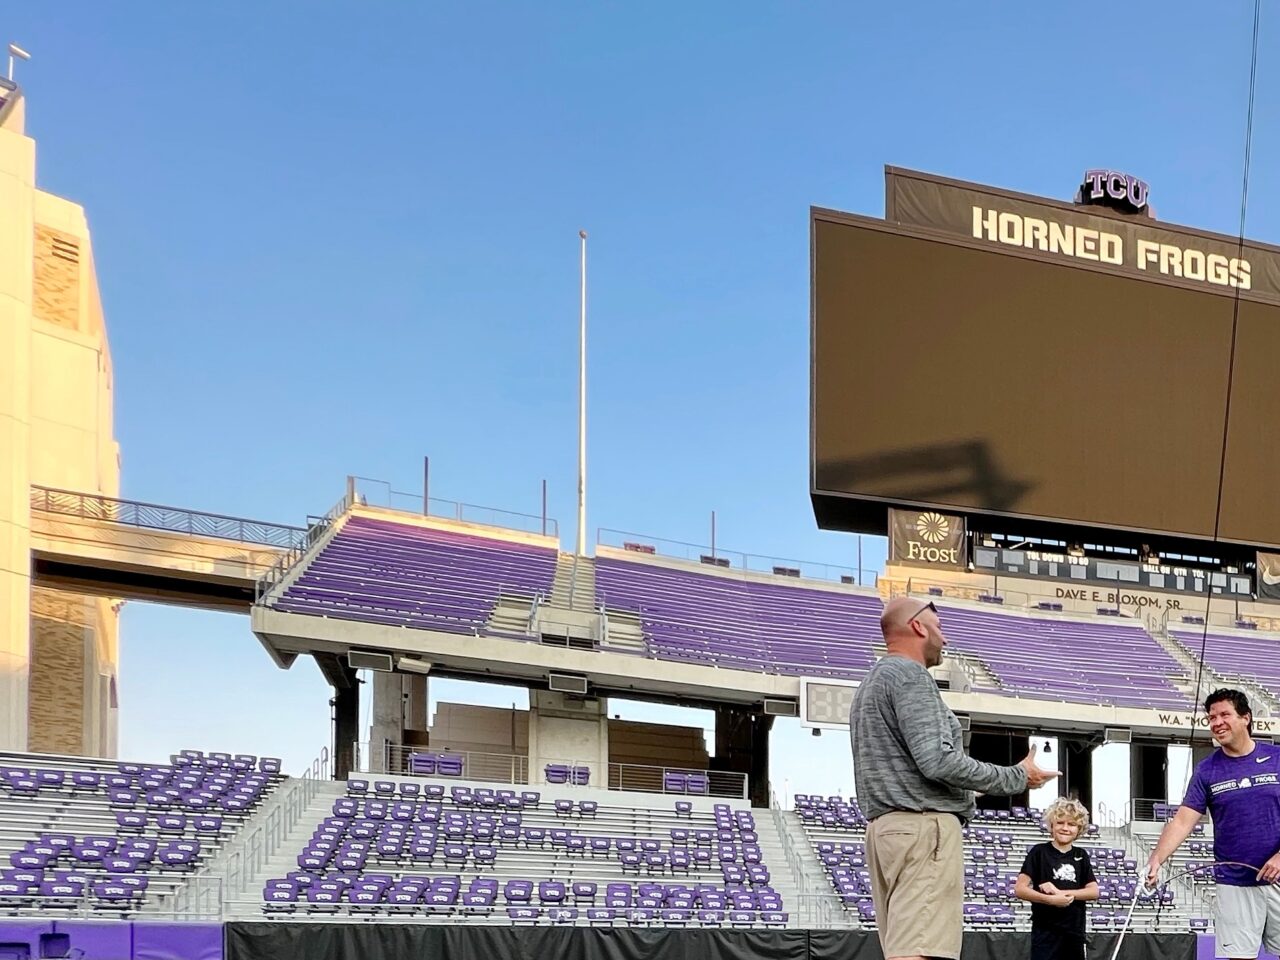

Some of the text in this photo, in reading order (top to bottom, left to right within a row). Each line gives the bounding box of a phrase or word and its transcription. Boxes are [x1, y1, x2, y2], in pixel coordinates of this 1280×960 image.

[1086, 169, 1150, 208] TCU
[972, 206, 1251, 290] HORNED FROGS
[907, 541, 957, 563] Frost
[1056, 588, 1087, 601] DAVE
[1159, 714, 1183, 726] W.A.
